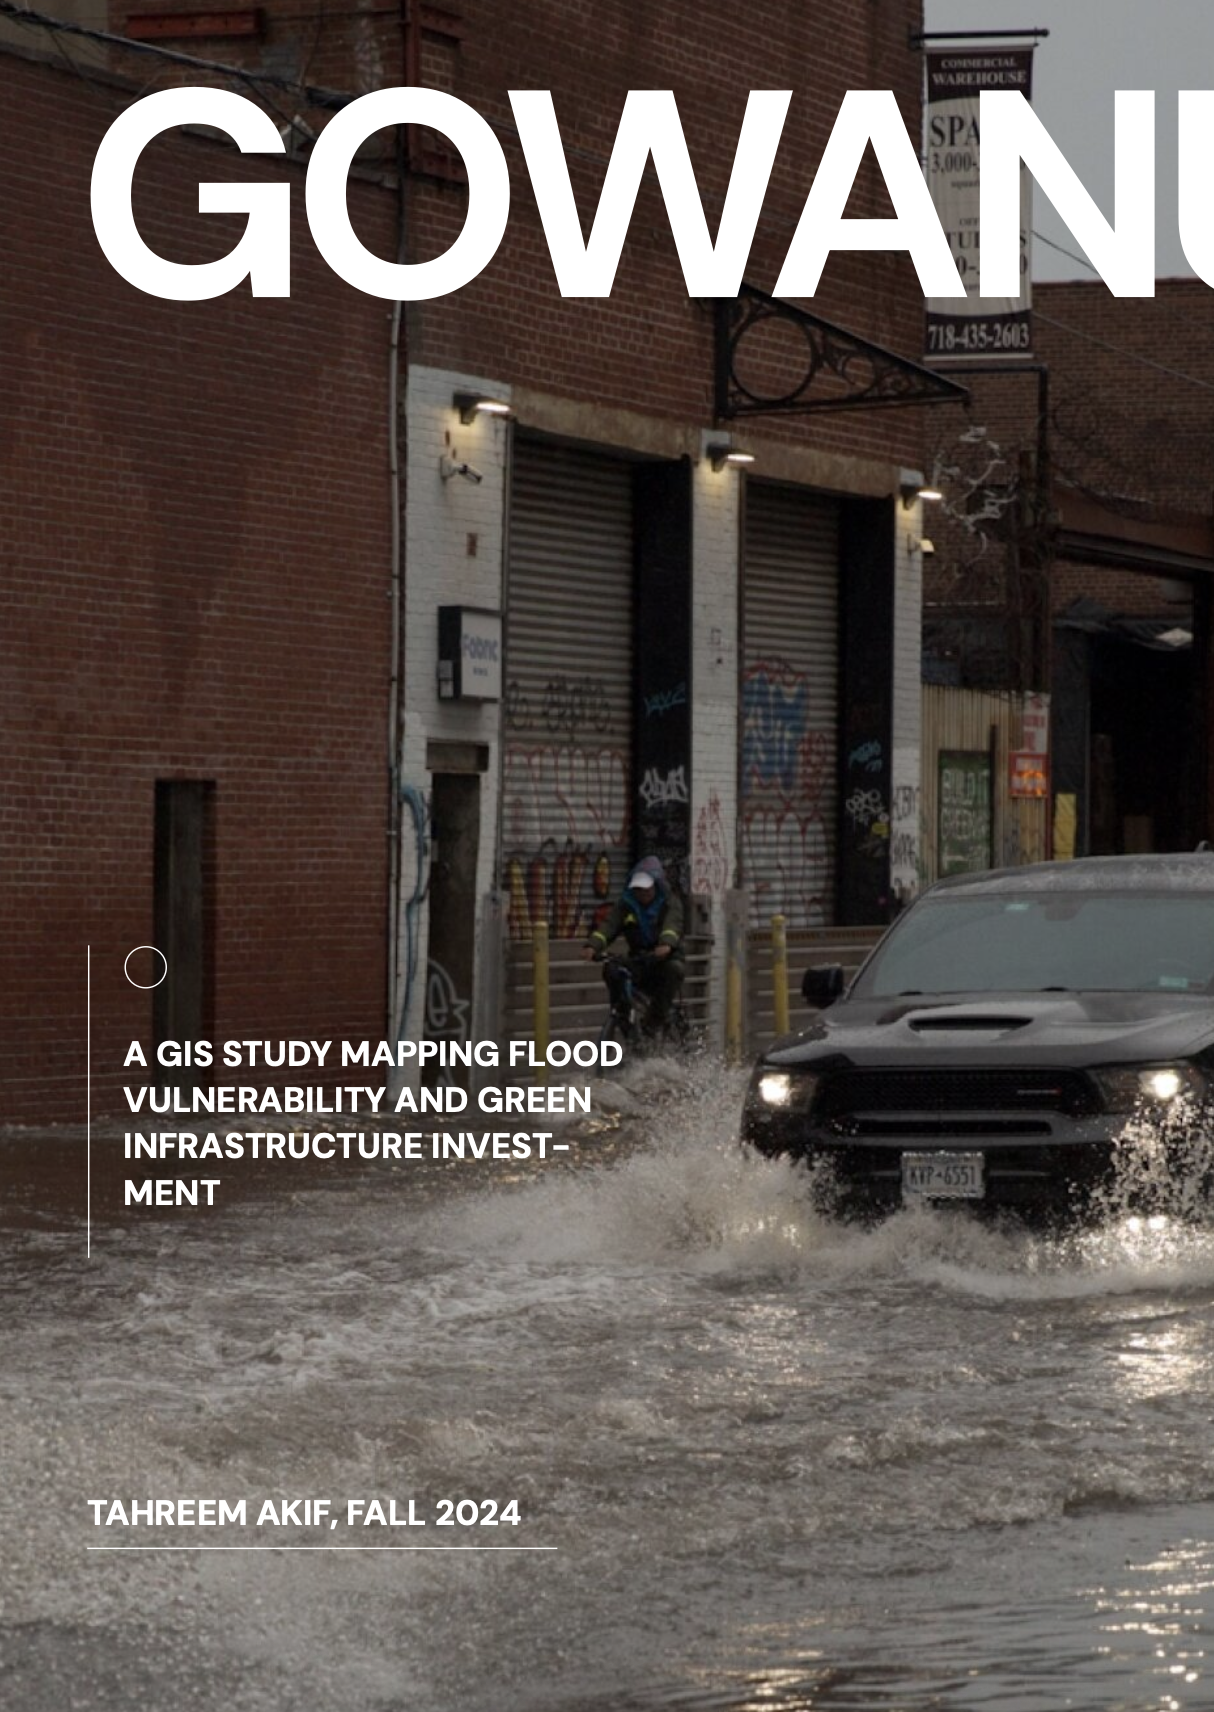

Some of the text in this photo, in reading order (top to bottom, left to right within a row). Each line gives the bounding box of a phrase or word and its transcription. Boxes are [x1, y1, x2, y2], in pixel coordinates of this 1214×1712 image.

[941, 58, 1016, 69] COMMERCIAL
[932, 70, 1027, 86] WAREHOUSE
[928, 323, 1029, 350] 718-435-2603
